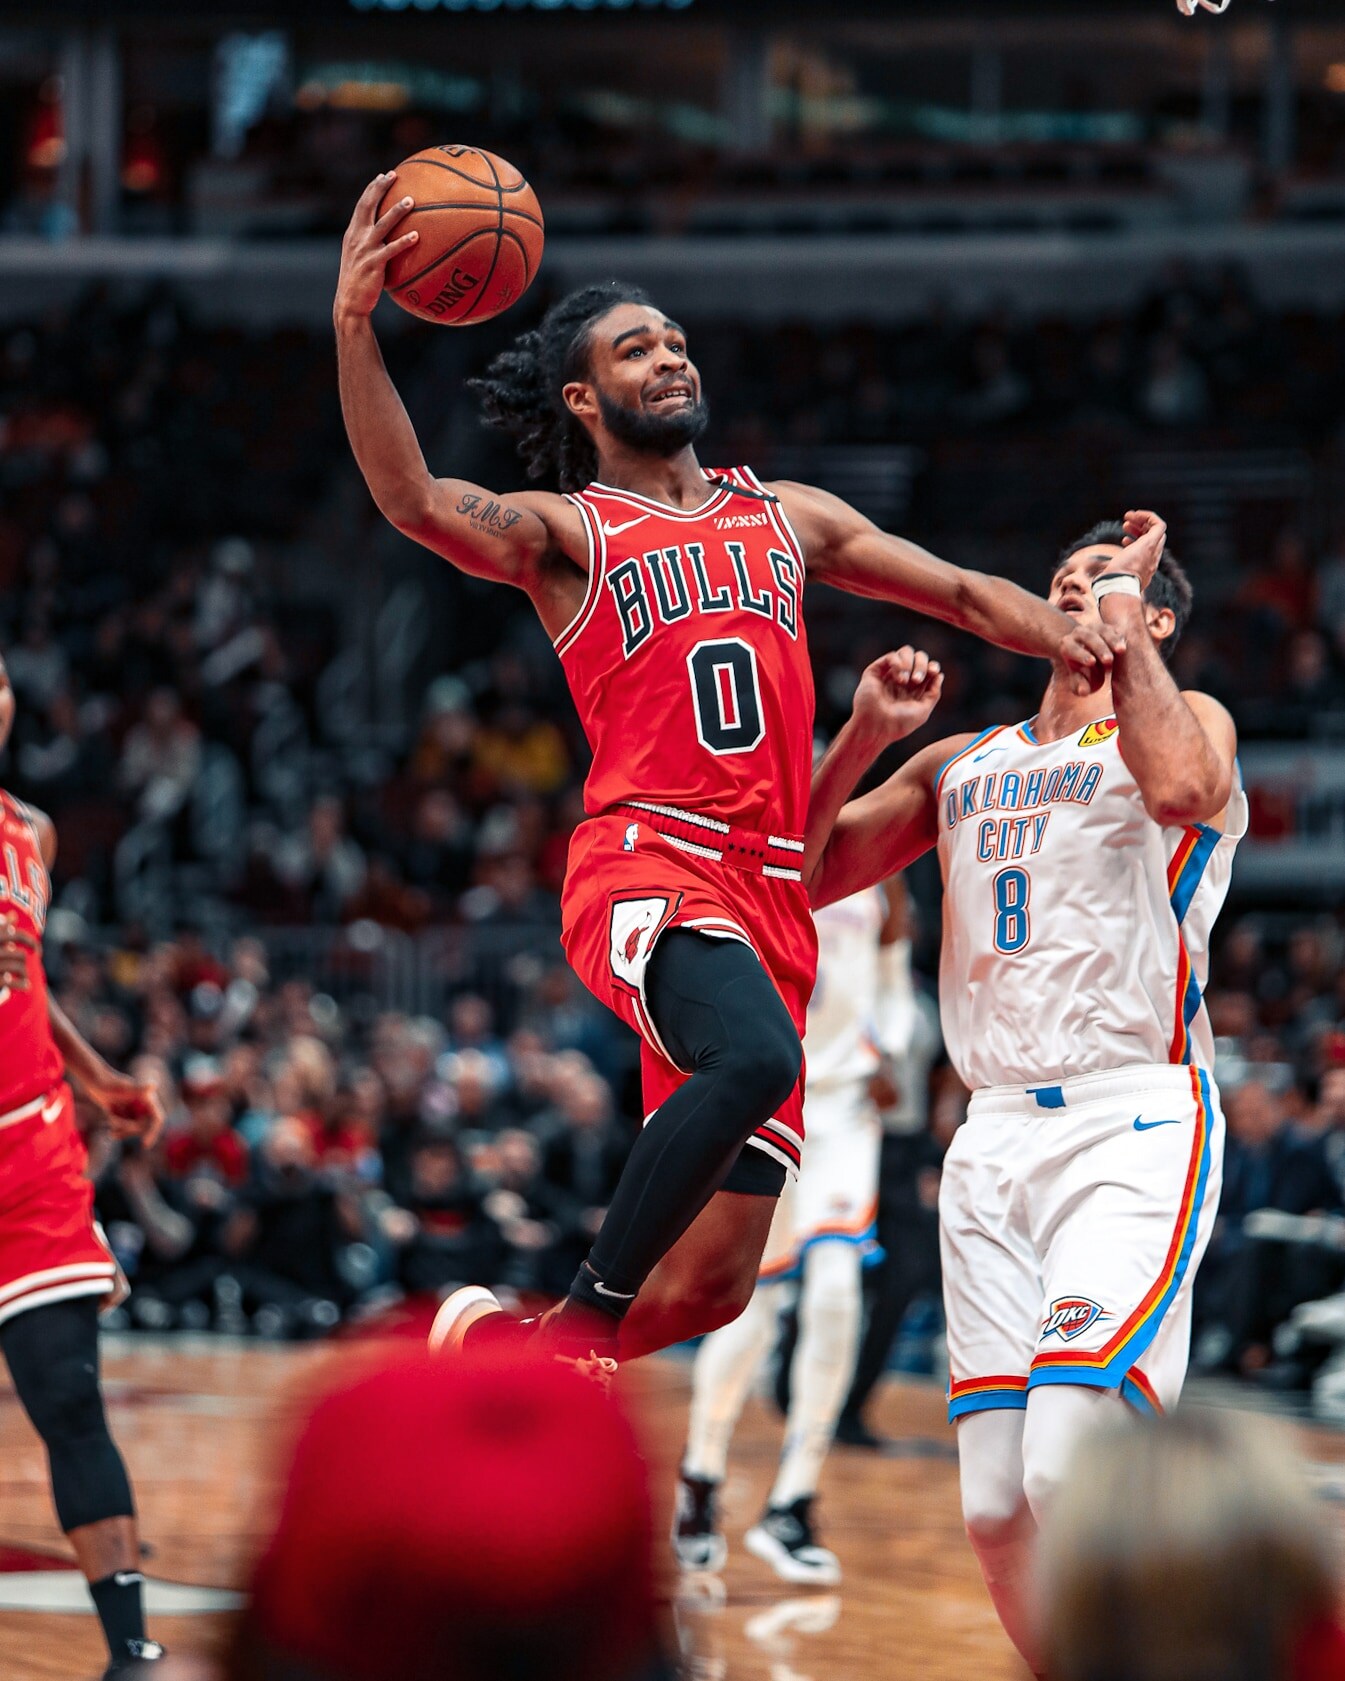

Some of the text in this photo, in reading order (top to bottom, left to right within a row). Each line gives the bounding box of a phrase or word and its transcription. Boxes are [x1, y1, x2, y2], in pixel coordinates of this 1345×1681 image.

[605, 541, 798, 661] BULLS
[686, 636, 766, 756] 0
[946, 761, 1104, 830] OKLAHOMA
[976, 811, 1051, 863] CITY
[992, 865, 1031, 956] 8
[1043, 1304, 1092, 1335] OKC
